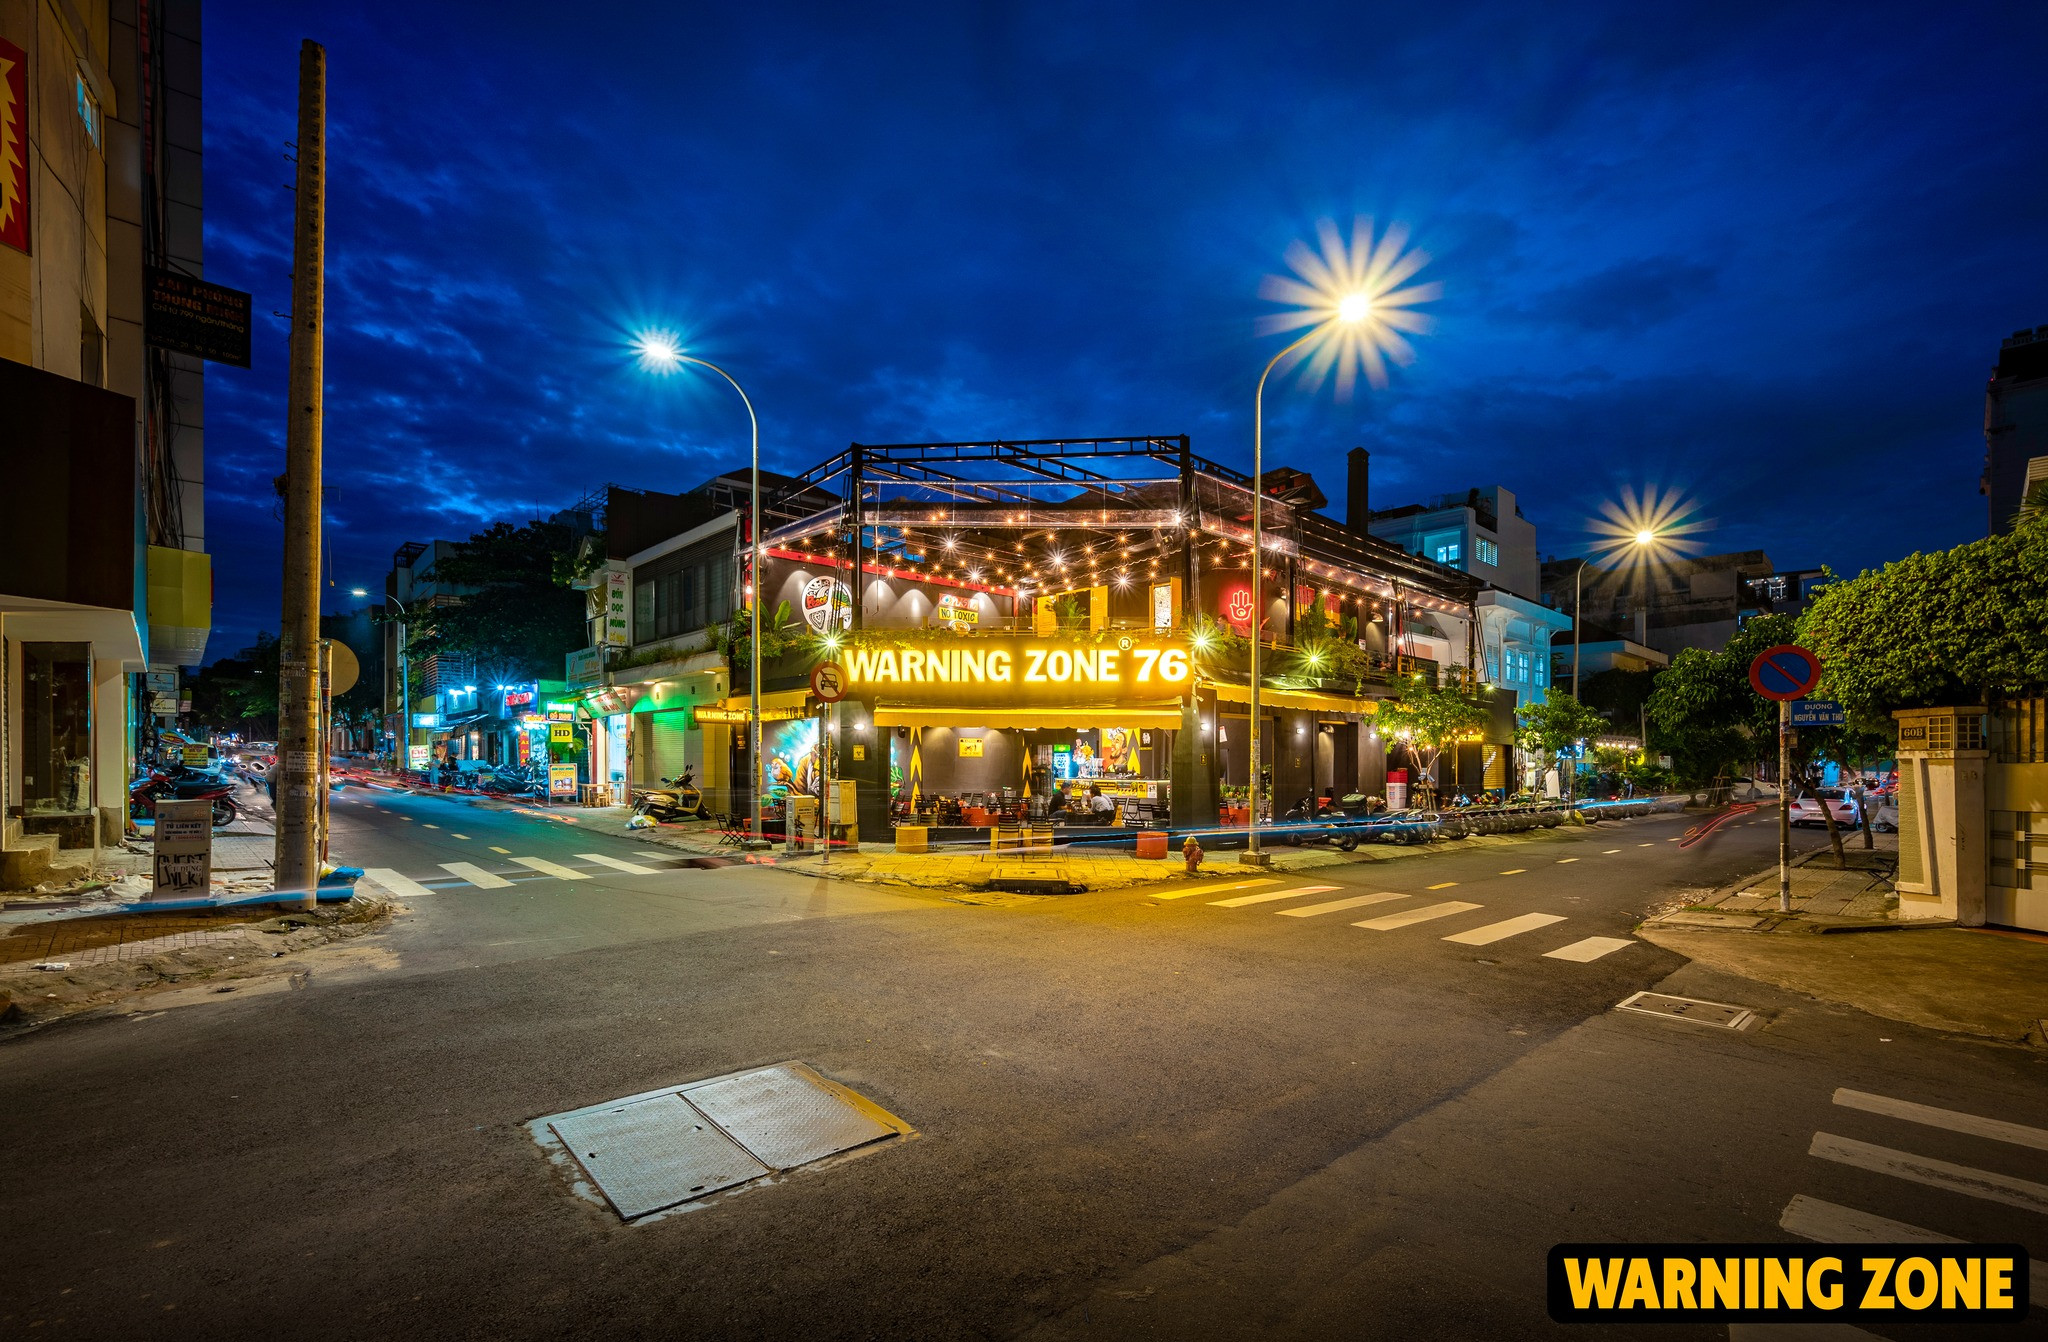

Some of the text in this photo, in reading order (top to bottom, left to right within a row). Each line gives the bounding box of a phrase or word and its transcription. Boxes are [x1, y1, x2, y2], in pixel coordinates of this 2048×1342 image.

[180, 310, 194, 319] 799
[941, 608, 976, 622] NO TOXIC
[845, 650, 1012, 682] WARNING
[1025, 650, 1119, 682] ZONE
[1133, 649, 1189, 682] 76
[696, 711, 745, 720] WARNING ZONE
[1903, 728, 1923, 737] 60B
